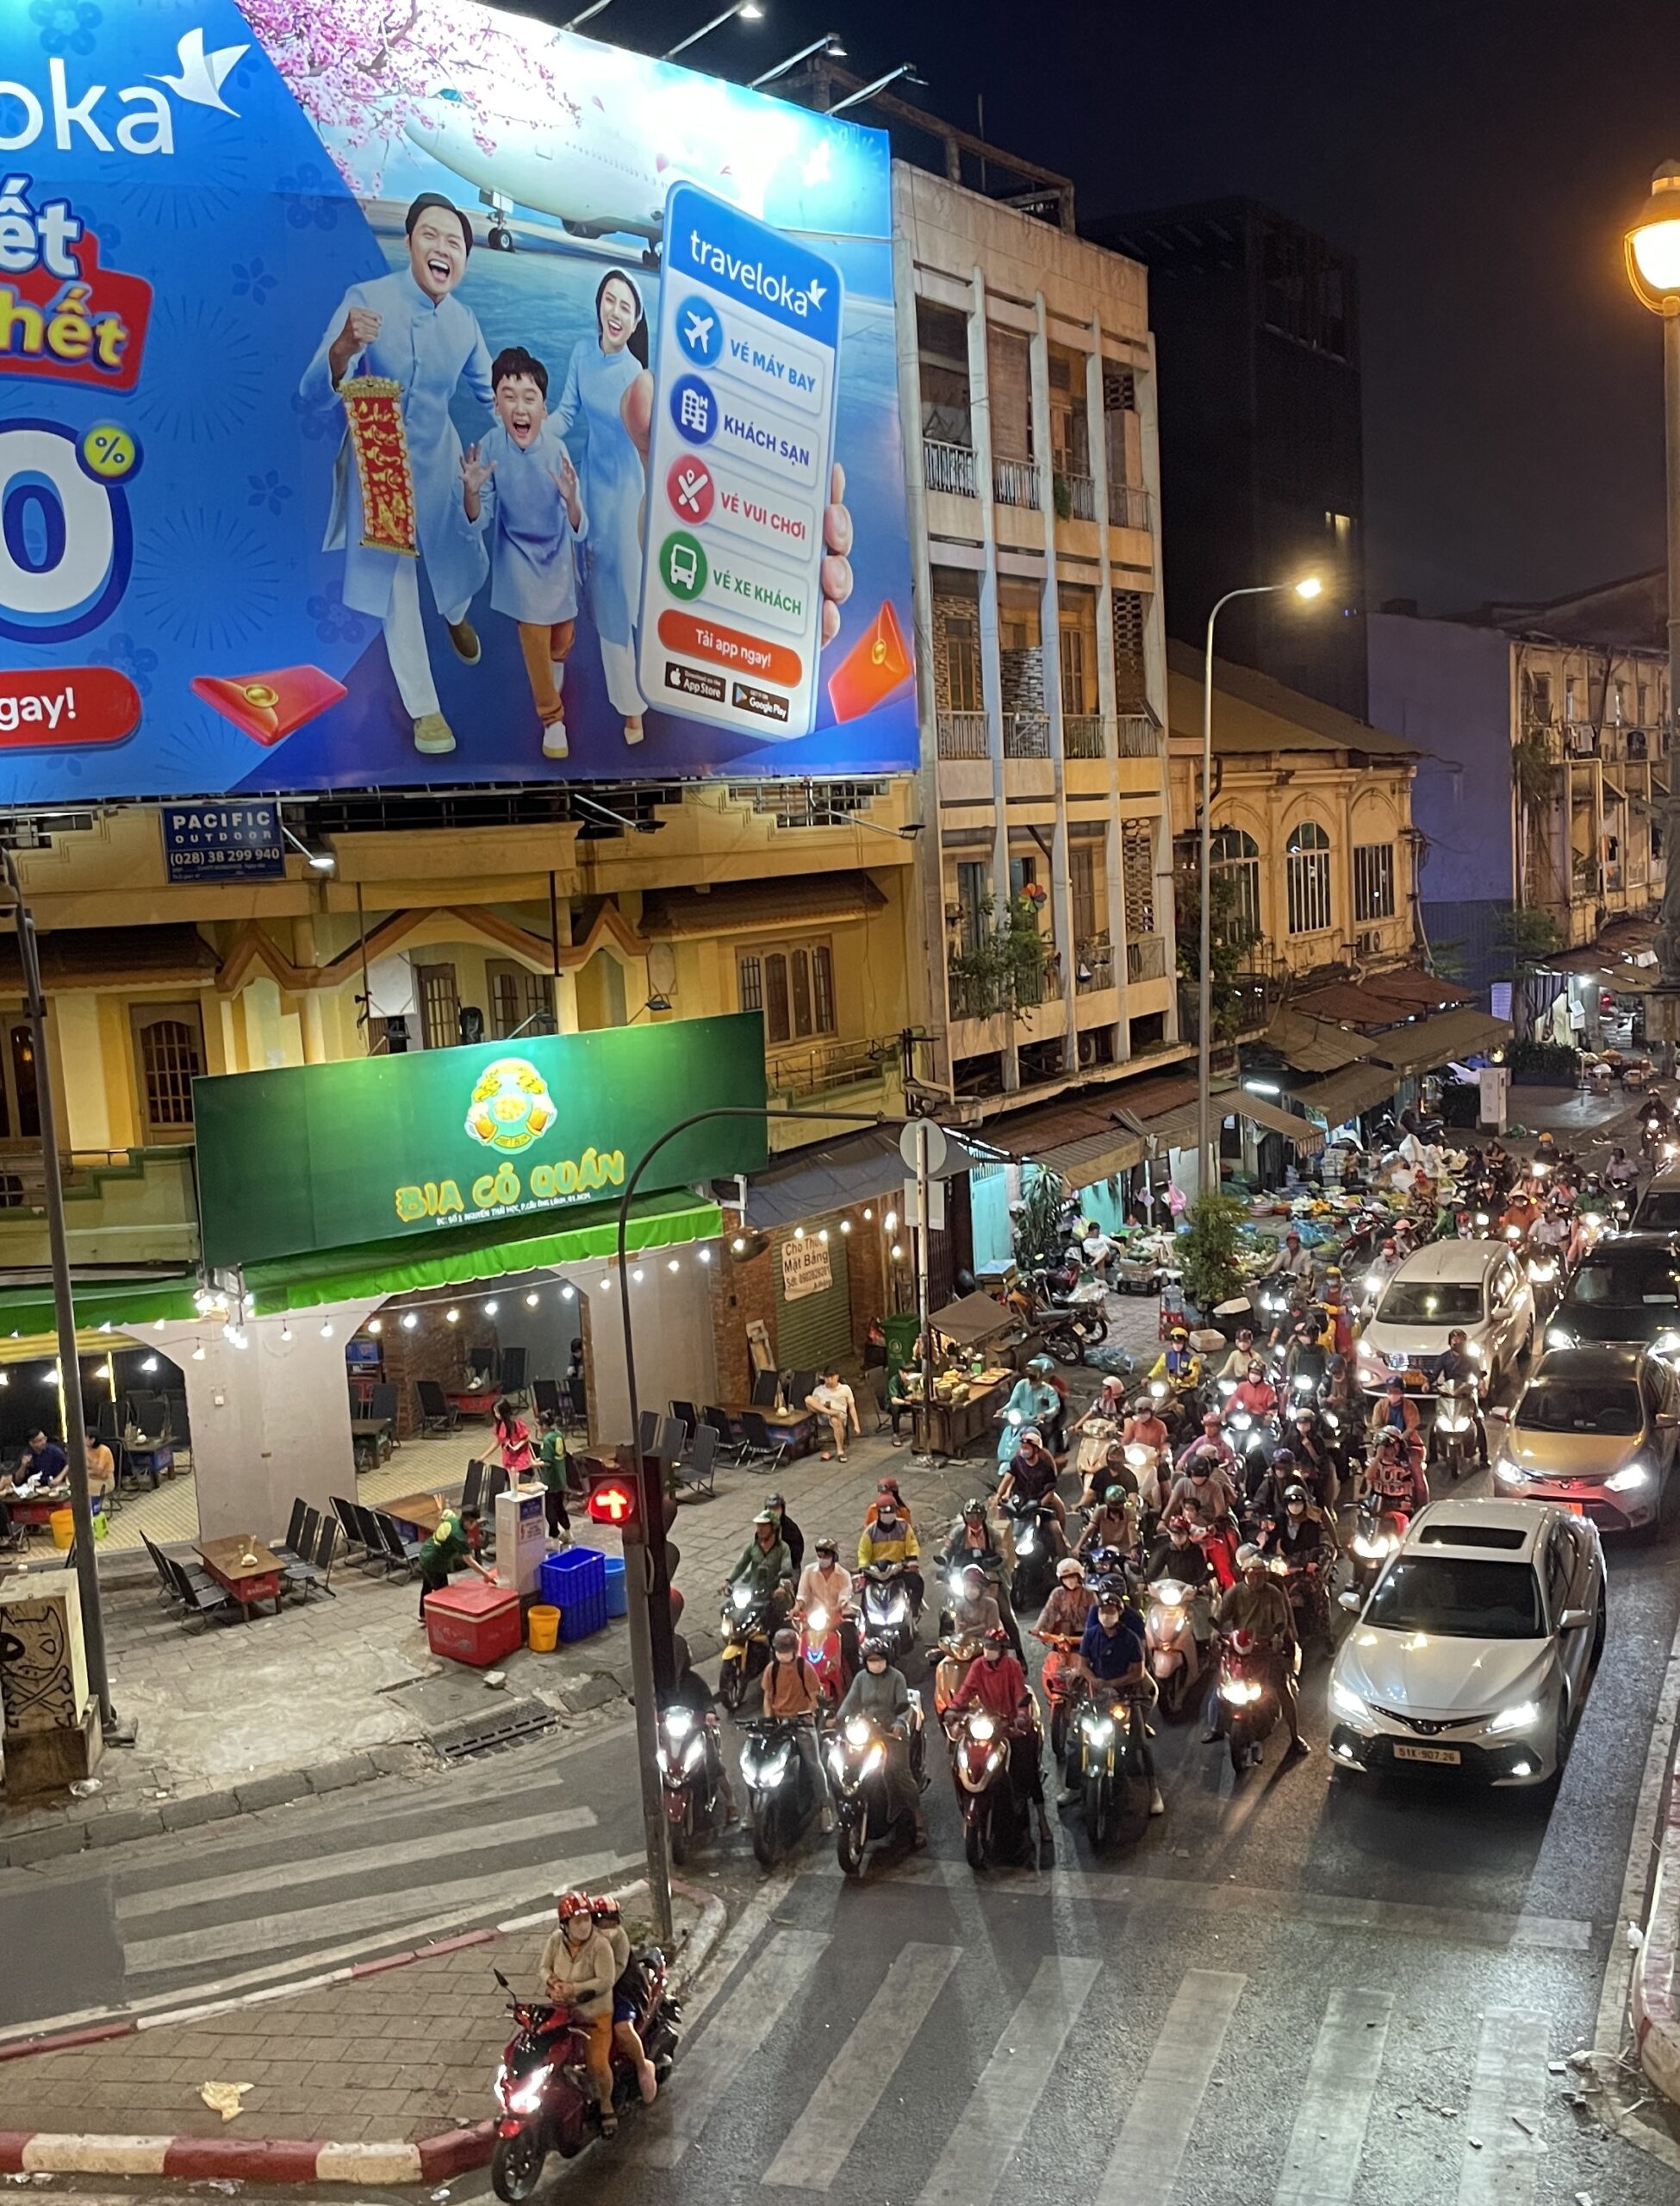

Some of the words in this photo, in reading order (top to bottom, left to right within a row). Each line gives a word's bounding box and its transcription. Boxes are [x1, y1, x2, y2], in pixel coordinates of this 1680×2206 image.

[690, 229, 807, 317] traveloka
[731, 338, 749, 363] VÉ
[753, 352, 785, 378] MÁY
[788, 368, 816, 393] BAY
[724, 414, 776, 452] KHÁCH
[780, 439, 810, 466] SẠN
[721, 492, 738, 514] VÉ
[743, 501, 767, 525] VUI
[770, 514, 806, 539] CHƠI
[713, 570, 731, 589] VÉ
[734, 577, 751, 596] XE
[755, 585, 802, 615] KHÁCH
[696, 628, 714, 648] Tải
[716, 639, 738, 658] app
[741, 647, 772, 670] ngay!
[683, 679, 700, 694] App
[700, 682, 721, 699] Store
[749, 696, 773, 714] Google
[773, 703, 787, 719] Play
[172, 812, 271, 830] PACIFIC
[175, 830, 271, 844] OUTDOOR
[171, 851, 205, 867] (028)
[208, 850, 225, 863] 38
[227, 849, 252, 862] 299
[255, 848, 280, 861] 940
[395, 1180, 464, 1222] BIA
[531, 1147, 625, 1198] QUÁN
[786, 1243, 803, 1256] Cho
